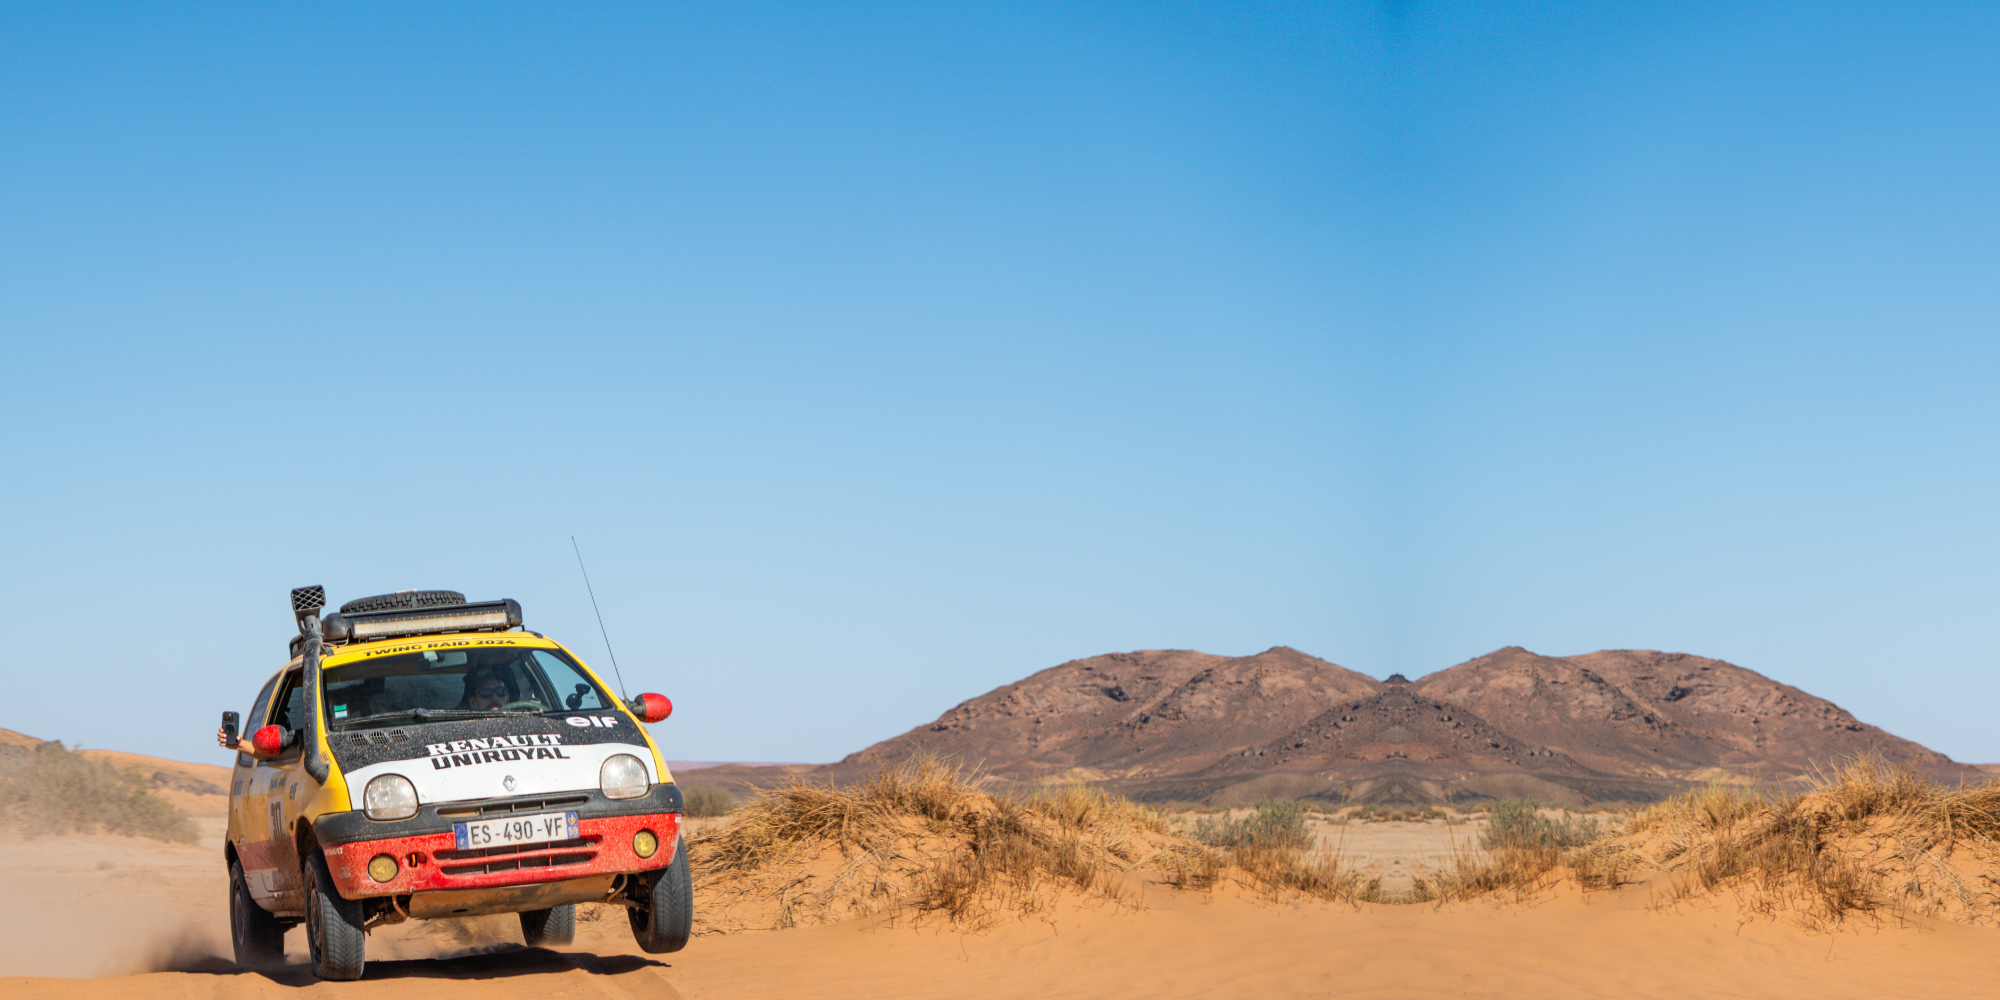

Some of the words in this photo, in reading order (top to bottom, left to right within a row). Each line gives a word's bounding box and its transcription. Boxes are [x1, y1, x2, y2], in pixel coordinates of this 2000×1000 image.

[364, 645, 422, 656] TWING
[428, 641, 470, 649] RAID
[566, 716, 618, 728] elf
[425, 734, 562, 756] RENAULT
[431, 747, 570, 770] UNIROYAL
